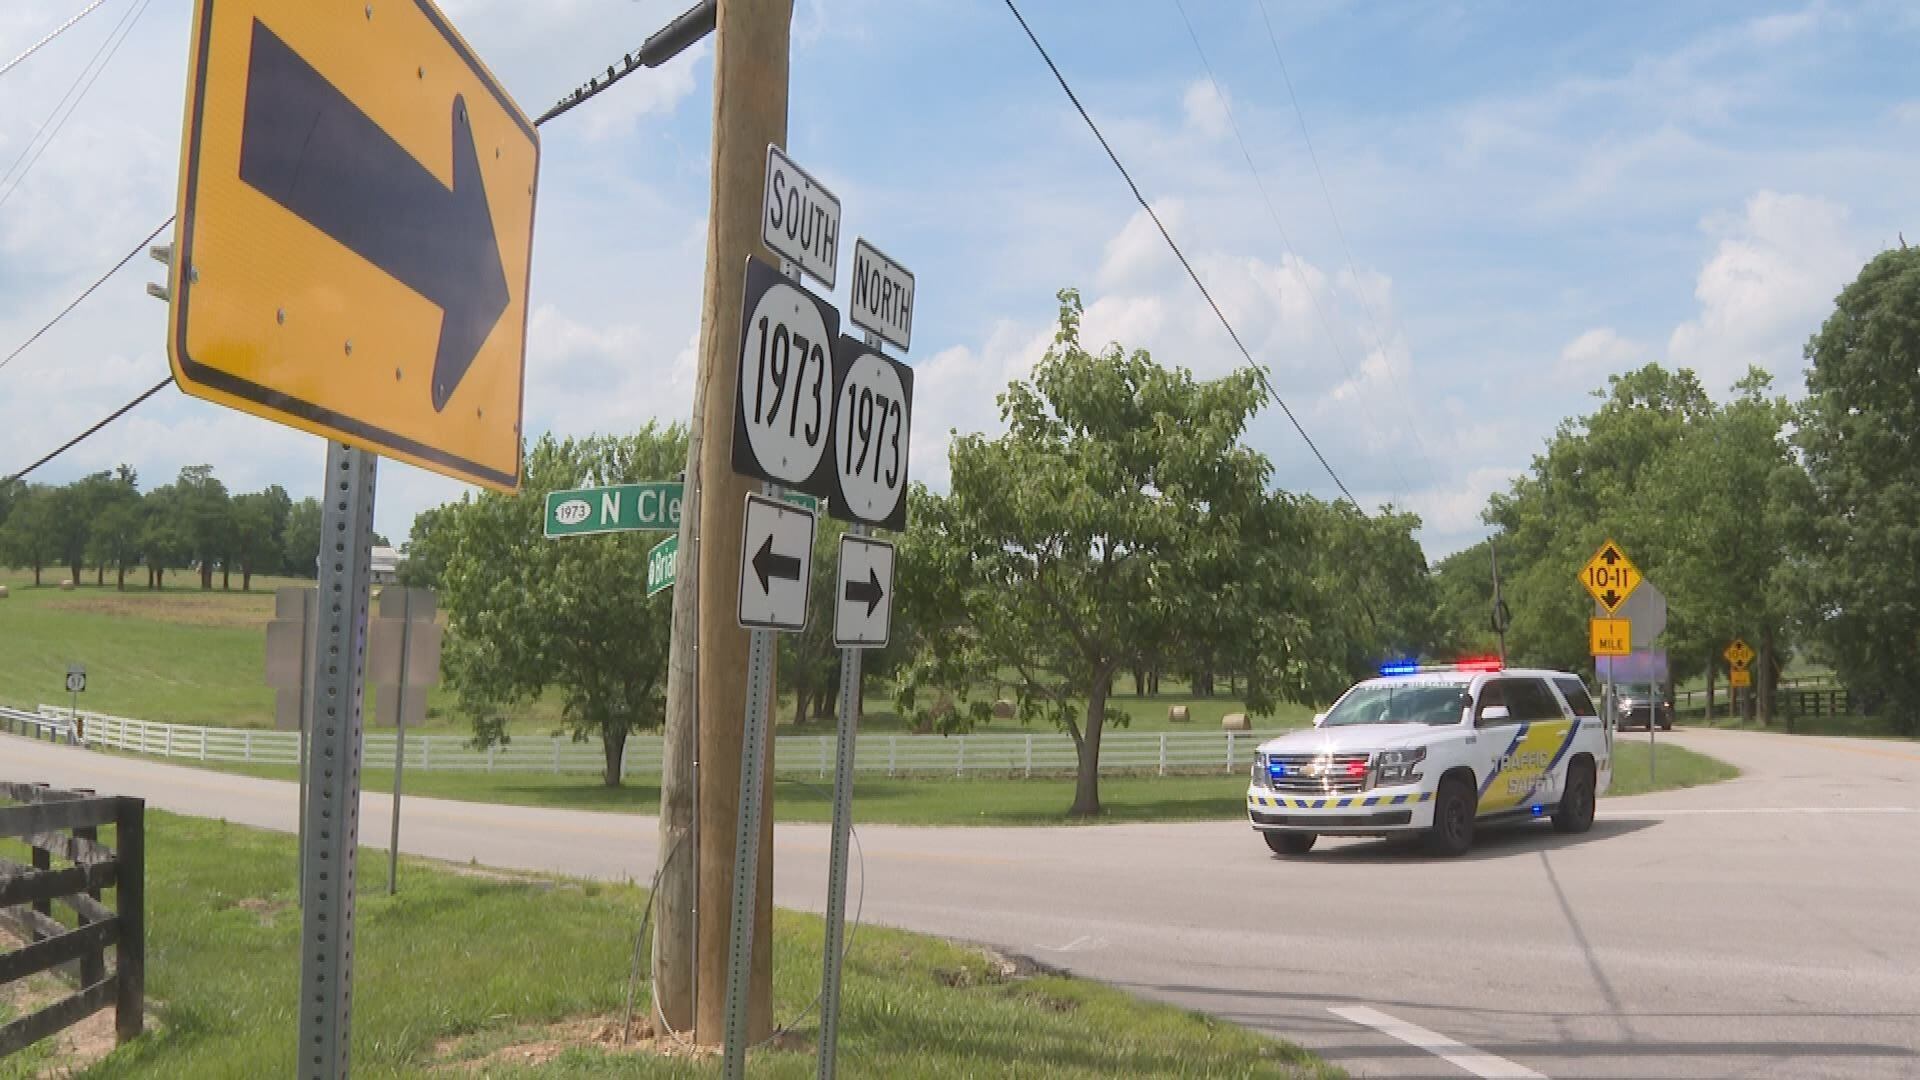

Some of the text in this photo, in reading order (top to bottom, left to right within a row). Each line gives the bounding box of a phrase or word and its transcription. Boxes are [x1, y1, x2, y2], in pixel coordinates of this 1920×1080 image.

[770, 169, 836, 257] SOUTH
[855, 256, 910, 332] NORTH
[754, 315, 824, 447] 1973
[848, 383, 901, 489] 1973
[561, 505, 586, 520] 1973
[601, 491, 621, 525] N
[1589, 567, 1628, 589] 10-11
[1599, 638, 1624, 651] MILE
[1491, 752, 1549, 772] TRAFFIC
[1508, 773, 1558, 793] SAFETY
